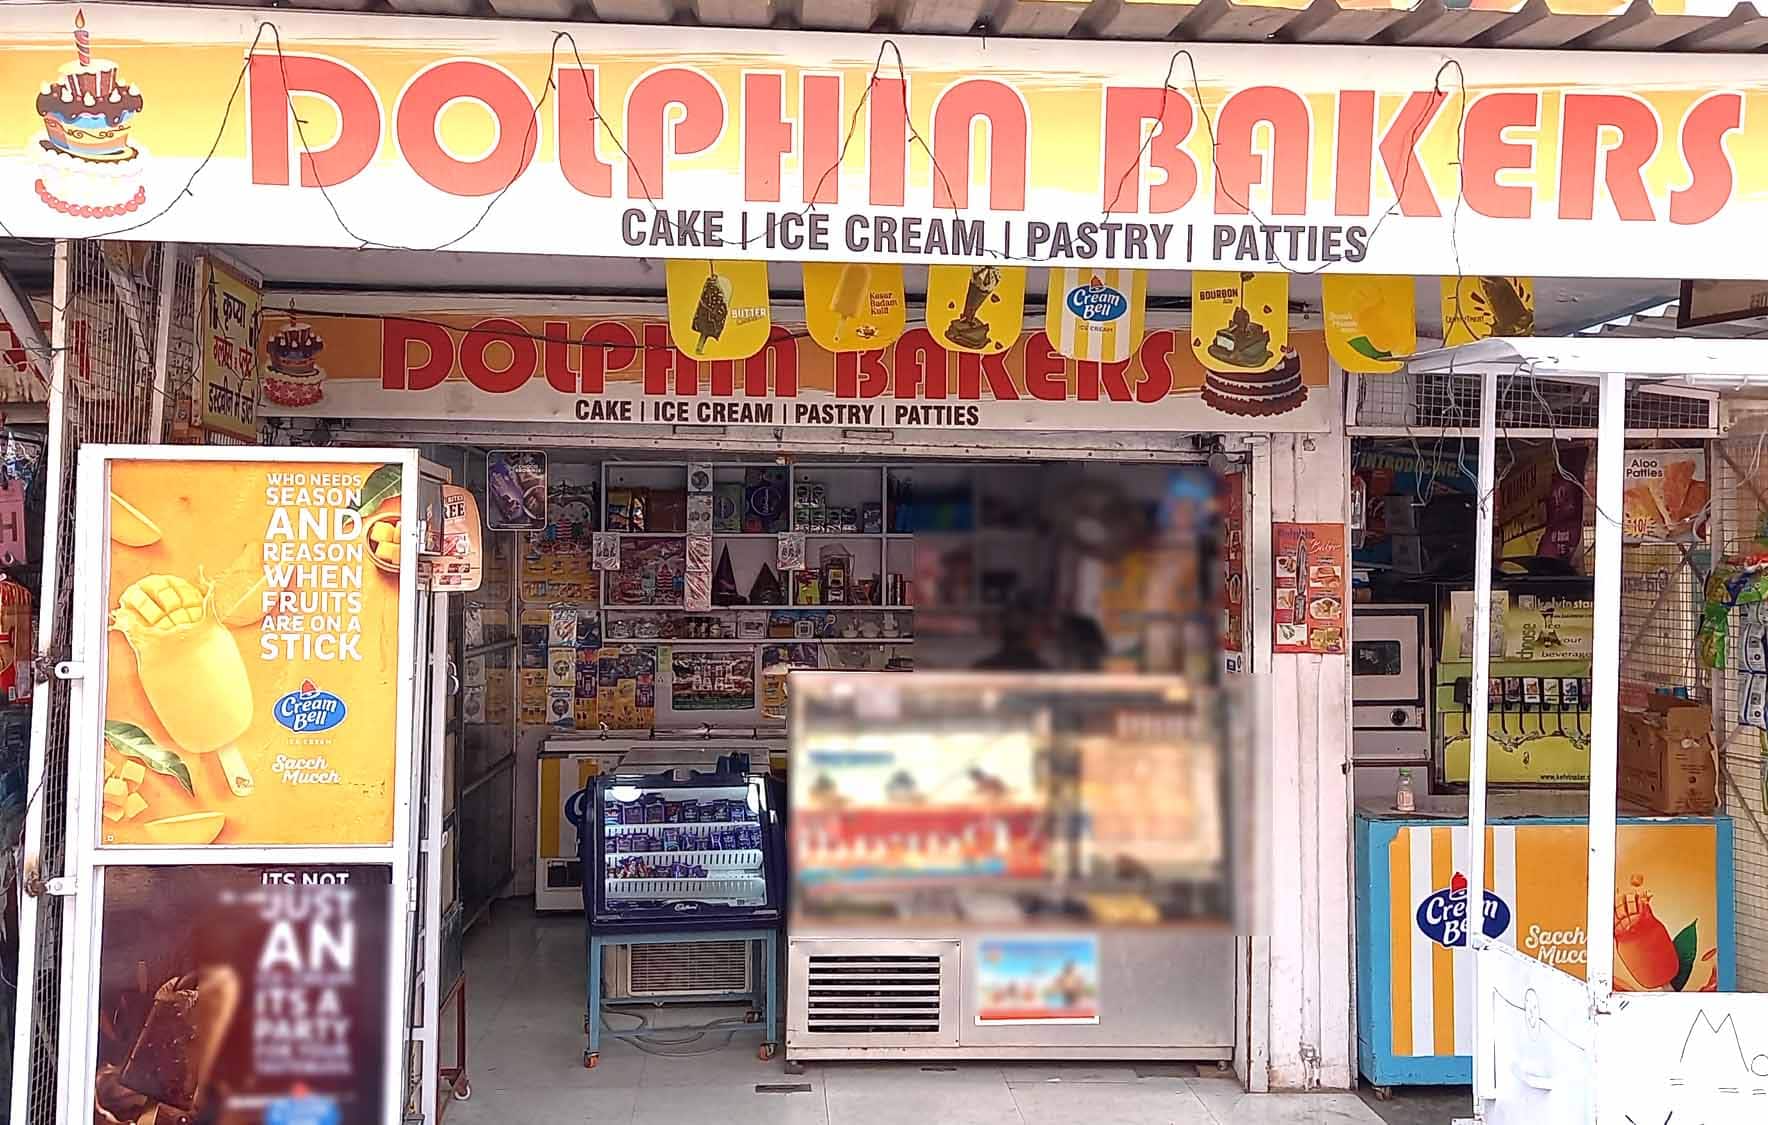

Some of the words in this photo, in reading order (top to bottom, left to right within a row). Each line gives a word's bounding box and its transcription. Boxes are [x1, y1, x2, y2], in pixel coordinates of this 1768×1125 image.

[248, 52, 1028, 211] DOLPHIN
[1103, 85, 1742, 225] BAKERS
[622, 208, 724, 248] CAKE
[766, 212, 829, 252] ICE
[845, 214, 985, 257] CREAM
[1027, 222, 1173, 260] PASTRY
[1212, 225, 1368, 262] PATTIES
[1072, 288, 1120, 308] Cream
[1199, 288, 1238, 301] BOURBON
[731, 307, 767, 319] BUTTER
[1083, 302, 1111, 318] Bell
[382, 318, 798, 398] DOLPHIN
[835, 328, 1175, 404] BAKERS
[575, 399, 632, 422] CAKE
[655, 401, 689, 422] ICE
[697, 402, 773, 423] CREAM
[796, 403, 875, 425] PASTRY
[896, 405, 979, 426] PATTIES
[1626, 468, 1663, 478] Patties
[1631, 458, 1658, 468] Aloo
[266, 473, 305, 487] WHO
[310, 473, 361, 487] NEEDS
[266, 487, 362, 506] SEASON
[265, 507, 363, 541] AND
[263, 543, 363, 562] REASON
[264, 565, 362, 589] WHEN
[262, 591, 363, 614] FRUITS
[261, 616, 304, 632] ARE
[311, 616, 341, 632] ON
[347, 616, 362, 632] A
[260, 633, 363, 661] STICK
[281, 696, 337, 717] Cream
[293, 710, 328, 731] Bell
[272, 755, 329, 773] Sacch
[281, 769, 343, 785] Mucch
[262, 873, 296, 886] ITS
[302, 873, 350, 886] NOT
[1426, 897, 1498, 924] Crem
[259, 921, 355, 970] AN
[1537, 945, 1587, 965] Mucc
